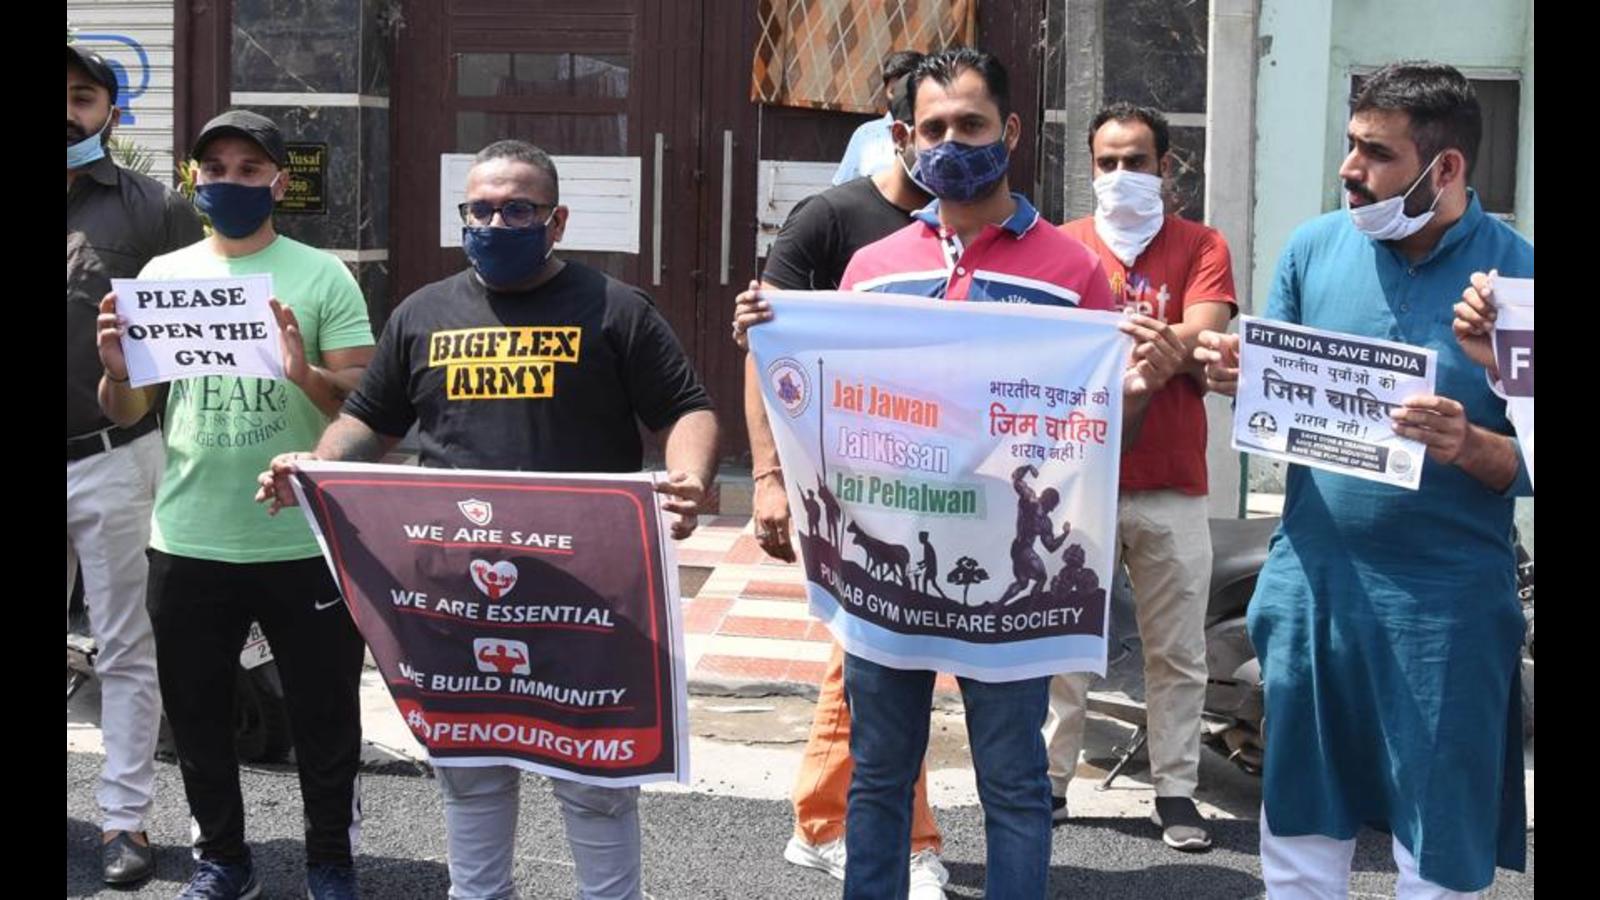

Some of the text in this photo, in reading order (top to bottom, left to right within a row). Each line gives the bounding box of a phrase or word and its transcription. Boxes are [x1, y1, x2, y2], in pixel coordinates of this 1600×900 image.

[136, 287, 247, 309] PLEASE
[127, 321, 268, 340] OPEN THE
[432, 329, 579, 363] BIGFLEX
[175, 350, 237, 366] GYM
[1251, 329, 1420, 371] FIT INDIA SAVE INDIA
[451, 364, 552, 397] ARMY
[1262, 367, 1316, 406] जिम
[1272, 354, 1319, 375] भारतीय
[1378, 374, 1396, 391] को
[833, 379, 864, 412] Jai
[868, 385, 939, 428] Jawan
[990, 378, 1040, 399] भारतीय
[1092, 386, 1110, 406] को
[217, 417, 288, 448] CLOTHING
[989, 402, 1108, 444] जिम चाहिए
[839, 426, 950, 475] Jai Kissan
[1011, 444, 1046, 461] शराब
[836, 473, 977, 514] Jai Pehalwan
[404, 525, 573, 549] WE ARE SAFE
[390, 589, 615, 627] WE ARE ESSENTIAL
[867, 594, 900, 622] GYM
[904, 608, 996, 633] WELFARE
[1001, 608, 1083, 633] SOCIETY
[398, 662, 627, 707] WE BUILD IMMUNITY
[407, 709, 635, 761] #OPENOURGYMS
